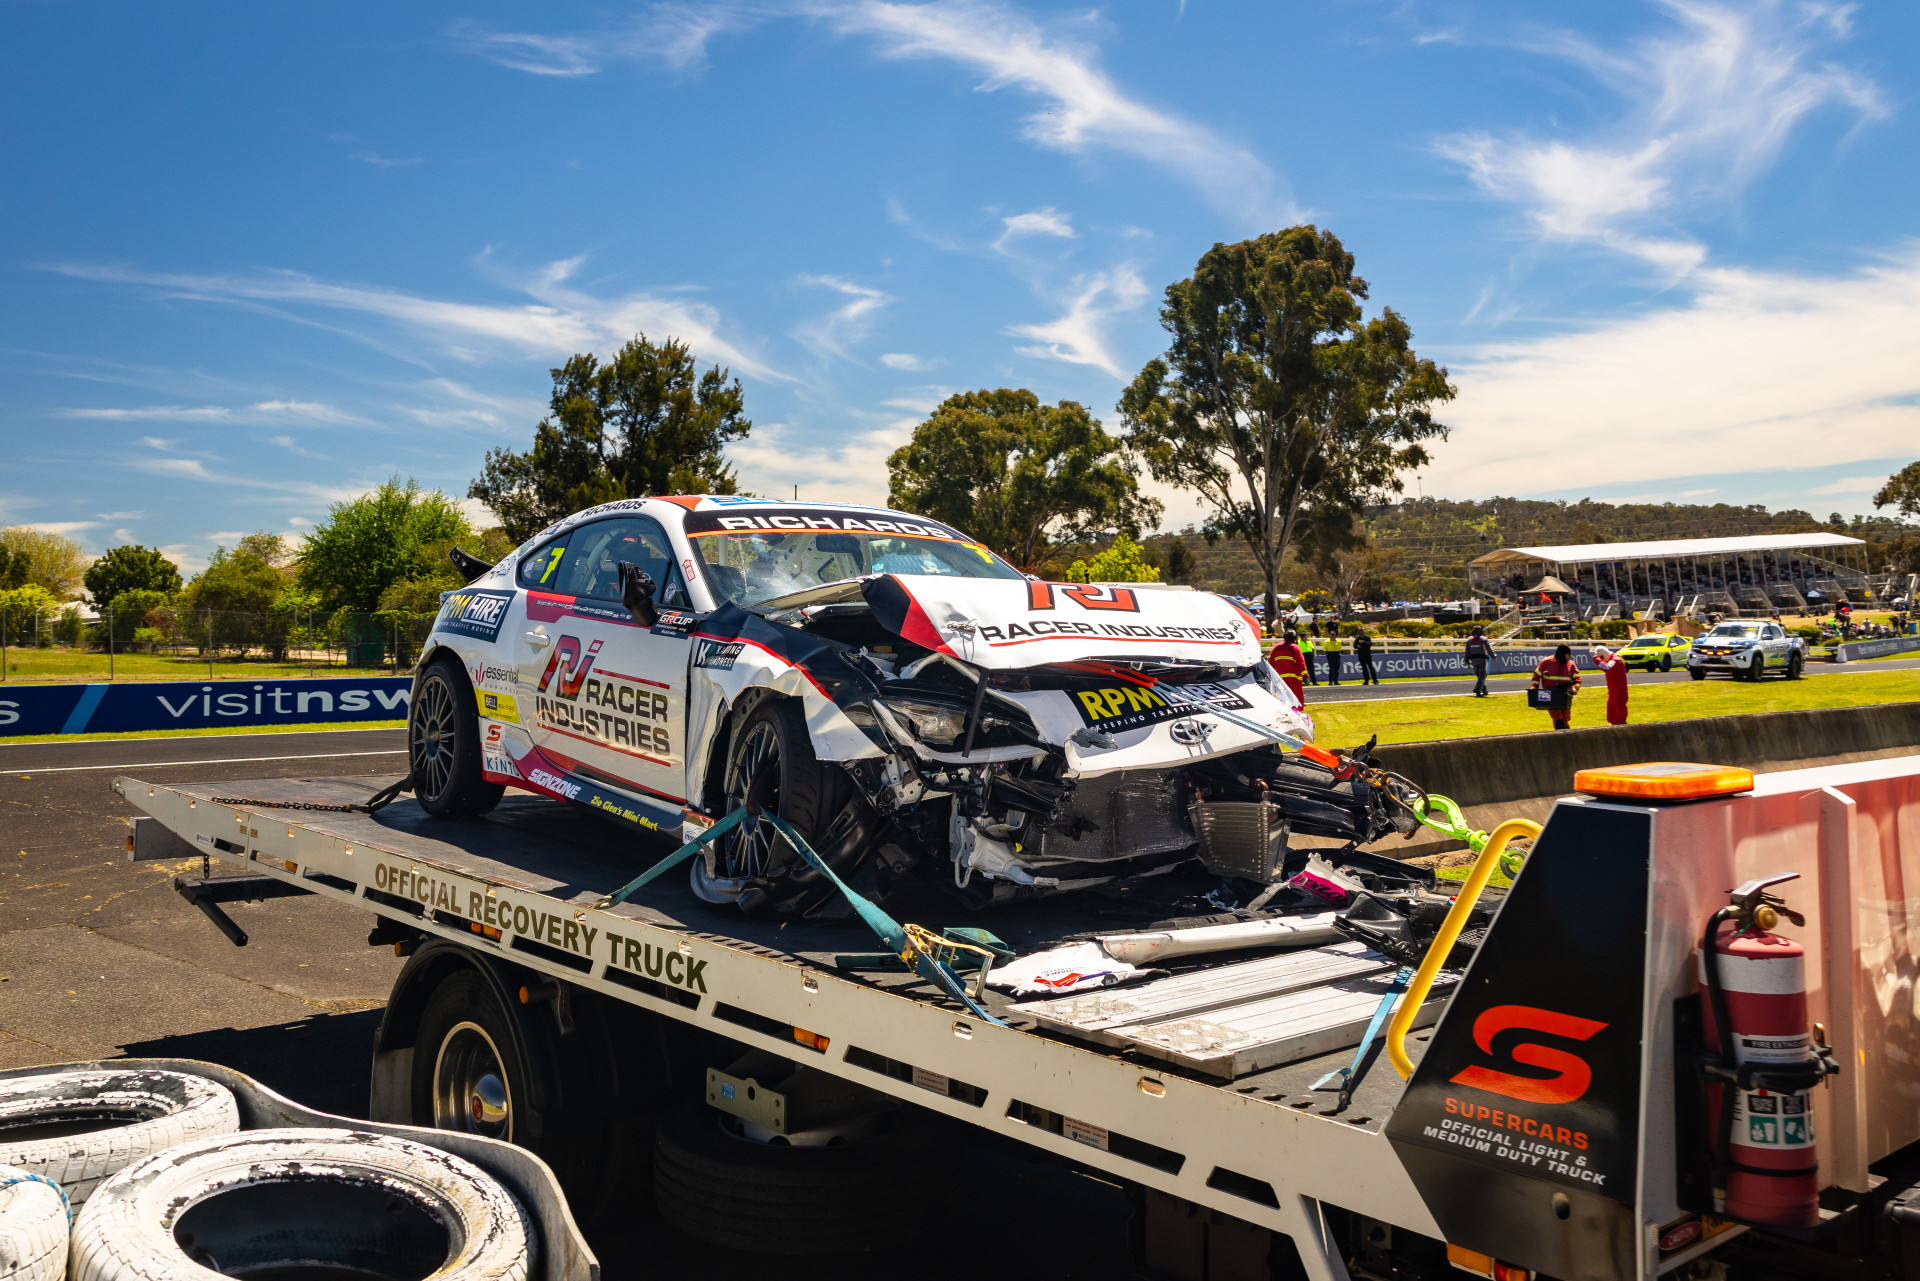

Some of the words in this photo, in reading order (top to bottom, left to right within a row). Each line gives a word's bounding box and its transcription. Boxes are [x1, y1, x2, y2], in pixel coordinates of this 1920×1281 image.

[580, 500, 647, 518] RICHARDS
[717, 516, 953, 540] RICHARDS
[465, 596, 506, 623] HIRE
[471, 626, 495, 636] MOVING
[977, 620, 1100, 642] RACER
[1098, 623, 1238, 640] INDUSTRIES
[1386, 655, 1432, 672] south
[1501, 652, 1589, 667] visitnsom
[485, 665, 519, 685] essential
[485, 696, 497, 708] BELL
[586, 679, 669, 723] RACER
[1077, 687, 1167, 721] RPM
[535, 696, 671, 756] INDUSTRIES
[1093, 715, 1146, 731] KEEPING
[1151, 704, 1199, 718] TRAFFIC
[528, 768, 582, 799] SIGNZONE
[590, 795, 602, 807] Zio
[602, 801, 623, 816] Glen's
[622, 809, 640, 823] Mini
[639, 816, 658, 831] Mart
[374, 862, 462, 915] OFFICIAL
[469, 891, 598, 957] RECOVERY
[606, 932, 709, 995] TRUCK
[1444, 1097, 1590, 1150] SUPERCARS
[1423, 1125, 1491, 1153] MEDIUM
[1495, 1146, 1542, 1167] DUTY
[1547, 1160, 1608, 1186] TRUCK
[1441, 1118, 1513, 1146] OFFICIAL
[1518, 1139, 1571, 1161] LIGHT
[1574, 1155, 1588, 1167] &
